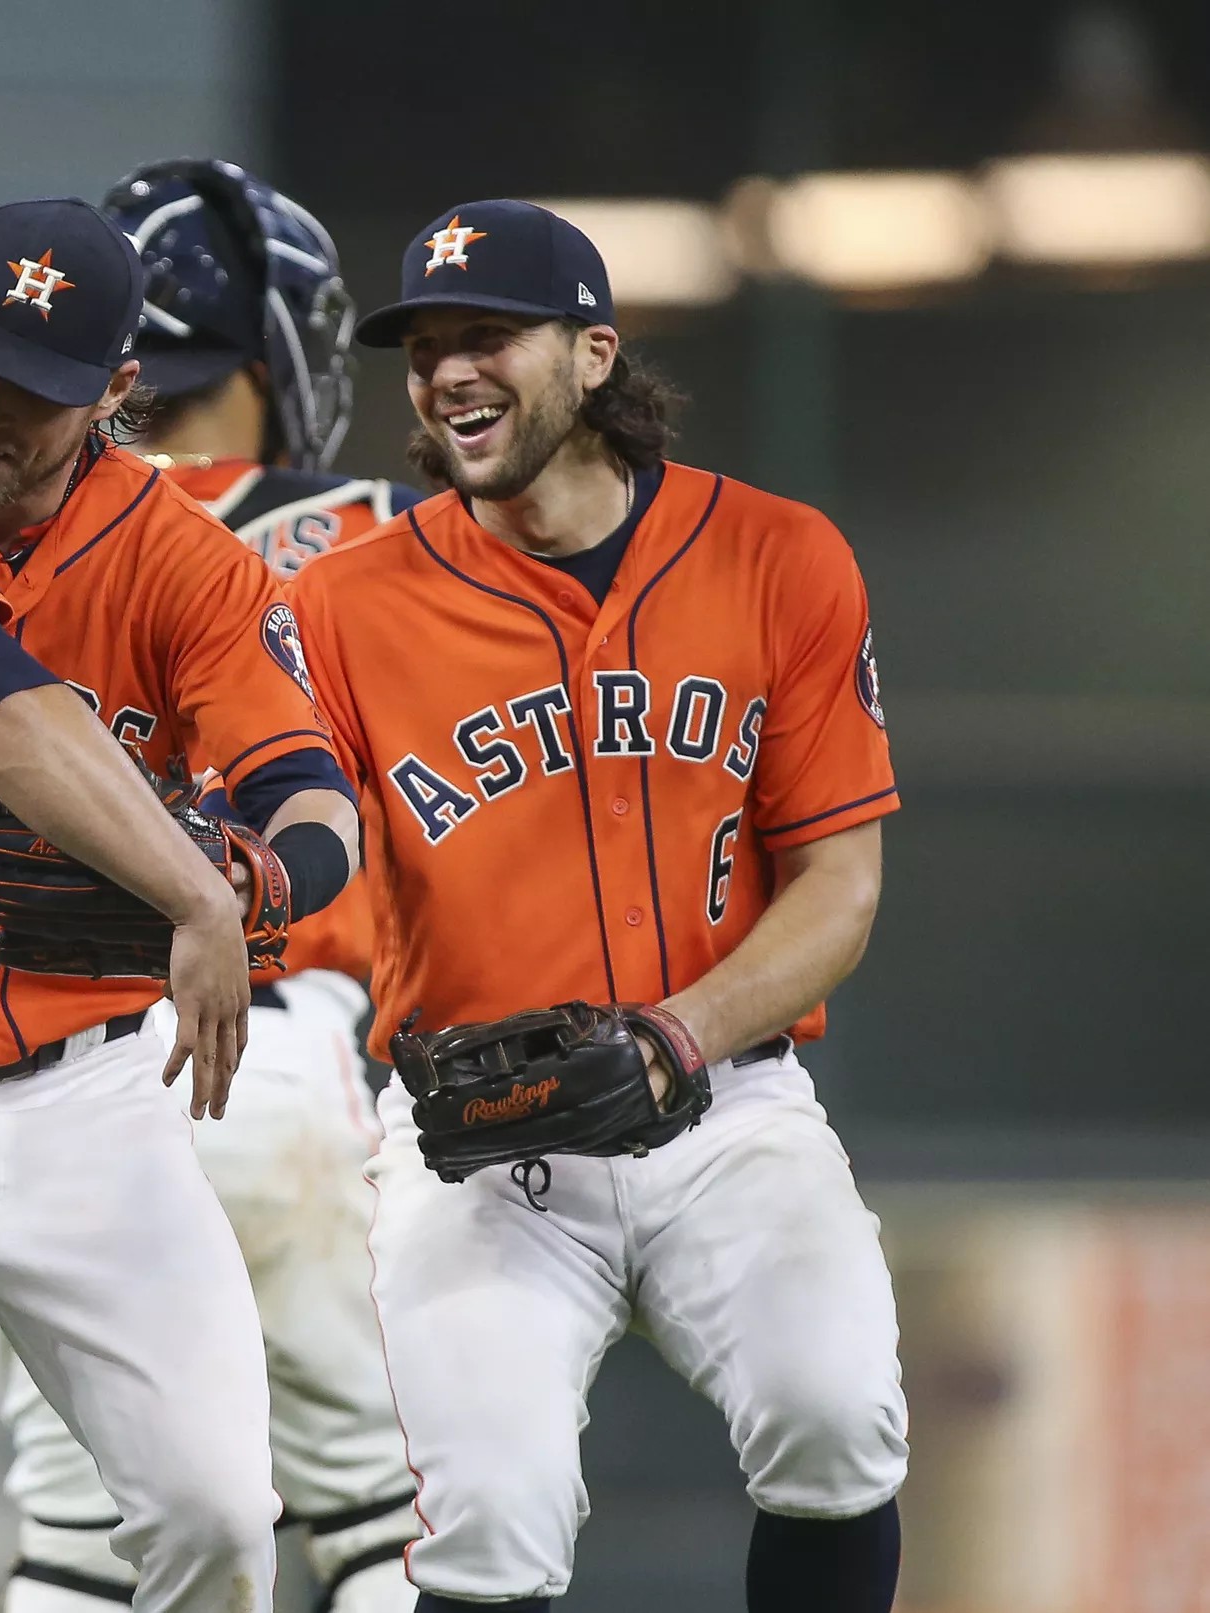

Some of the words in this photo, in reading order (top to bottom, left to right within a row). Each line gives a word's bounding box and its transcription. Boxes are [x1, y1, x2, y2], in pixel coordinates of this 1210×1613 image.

[426, 226, 475, 269] H
[6, 257, 66, 312] H
[386, 670, 767, 846] ASTROS
[705, 806, 745, 926] 6
[462, 1076, 561, 1125] Rawlings
